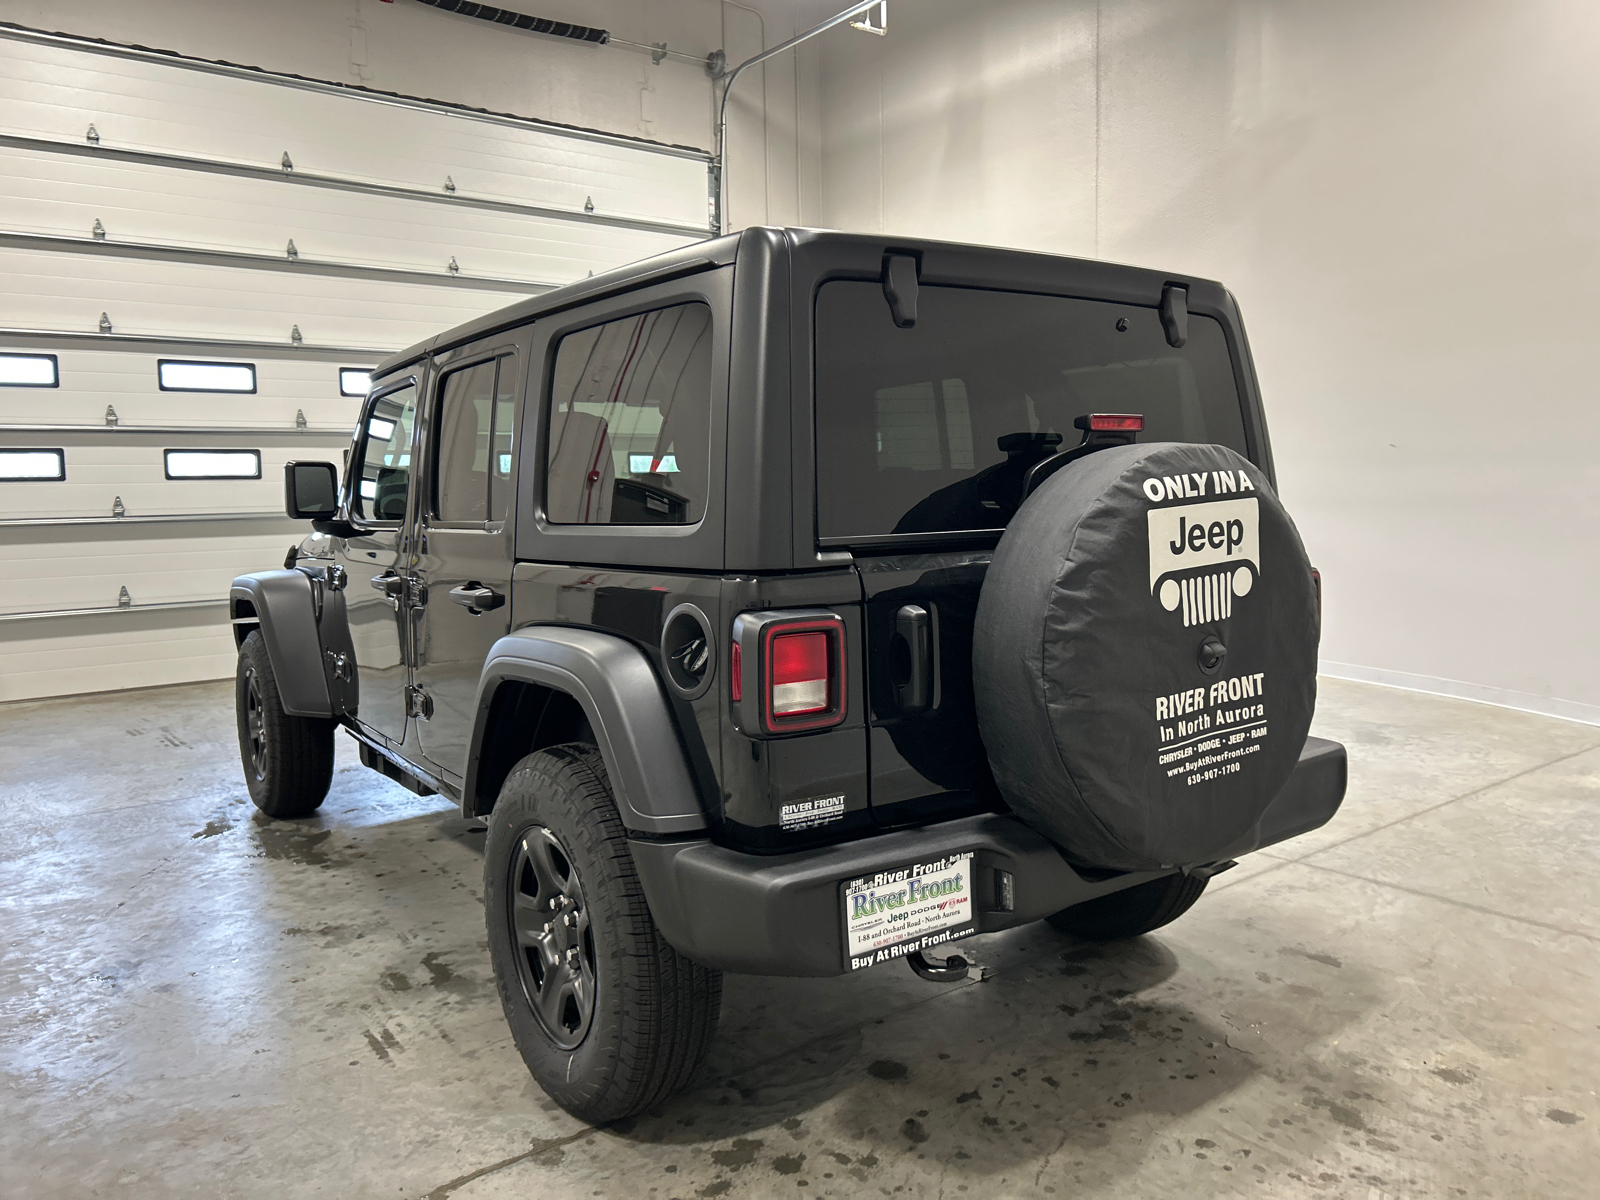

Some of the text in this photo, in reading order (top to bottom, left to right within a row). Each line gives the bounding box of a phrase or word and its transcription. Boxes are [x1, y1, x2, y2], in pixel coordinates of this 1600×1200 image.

[1143, 470, 1255, 502] ONLY IN A
[1170, 517, 1243, 555] Jeep
[1156, 673, 1264, 721] RIVER FRONT
[1160, 704, 1264, 742] In North Aurora
[1159, 727, 1267, 765] CHRYSLER DODGE JEEP RAM
[1167, 744, 1260, 777] www.BuyAtRiverFront.com
[1188, 762, 1240, 785] 630-907-1700
[782, 802, 812, 814] RIVER
[815, 796, 845, 809] FRONT
[874, 859, 945, 886] River Front
[852, 873, 963, 920] River Front
[872, 931, 882, 939] and
[883, 923, 905, 935] Orchard
[907, 920, 920, 928] Road
[925, 914, 941, 924] North
[942, 910, 960, 919] Aurora
[887, 911, 908, 923] Jeep
[911, 904, 941, 915] DODGE
[852, 928, 974, 969] Buy At River Front.com
